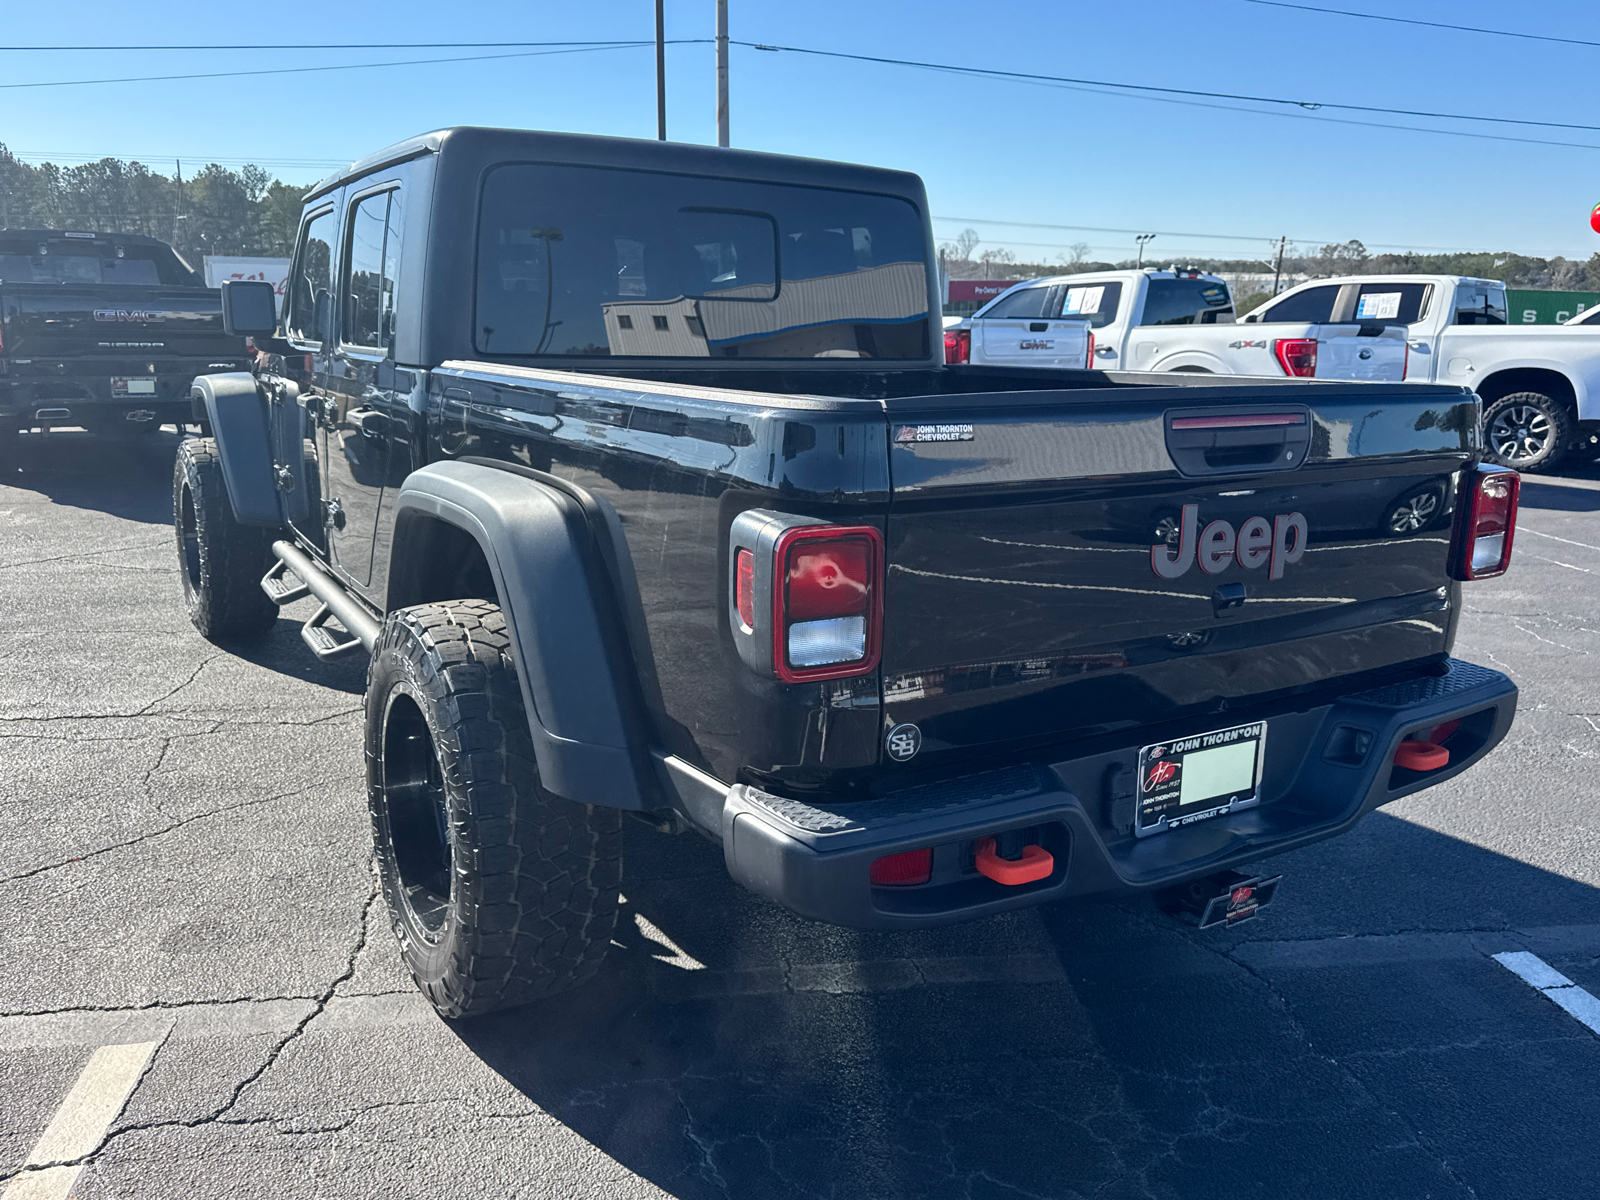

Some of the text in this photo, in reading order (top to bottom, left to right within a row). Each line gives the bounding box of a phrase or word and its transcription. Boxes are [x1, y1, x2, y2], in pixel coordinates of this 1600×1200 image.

[93, 309, 166, 323] GMC
[1020, 339, 1055, 350] GMC
[916, 425, 935, 434] JOHN
[936, 424, 973, 433] THORNTON
[916, 433, 960, 441] CHEVROLET
[1150, 503, 1308, 580] Jeep
[1170, 739, 1200, 754] JOHN
[1142, 791, 1180, 805] JOHN THORNTON
[1182, 810, 1218, 824] CHEVROLET
